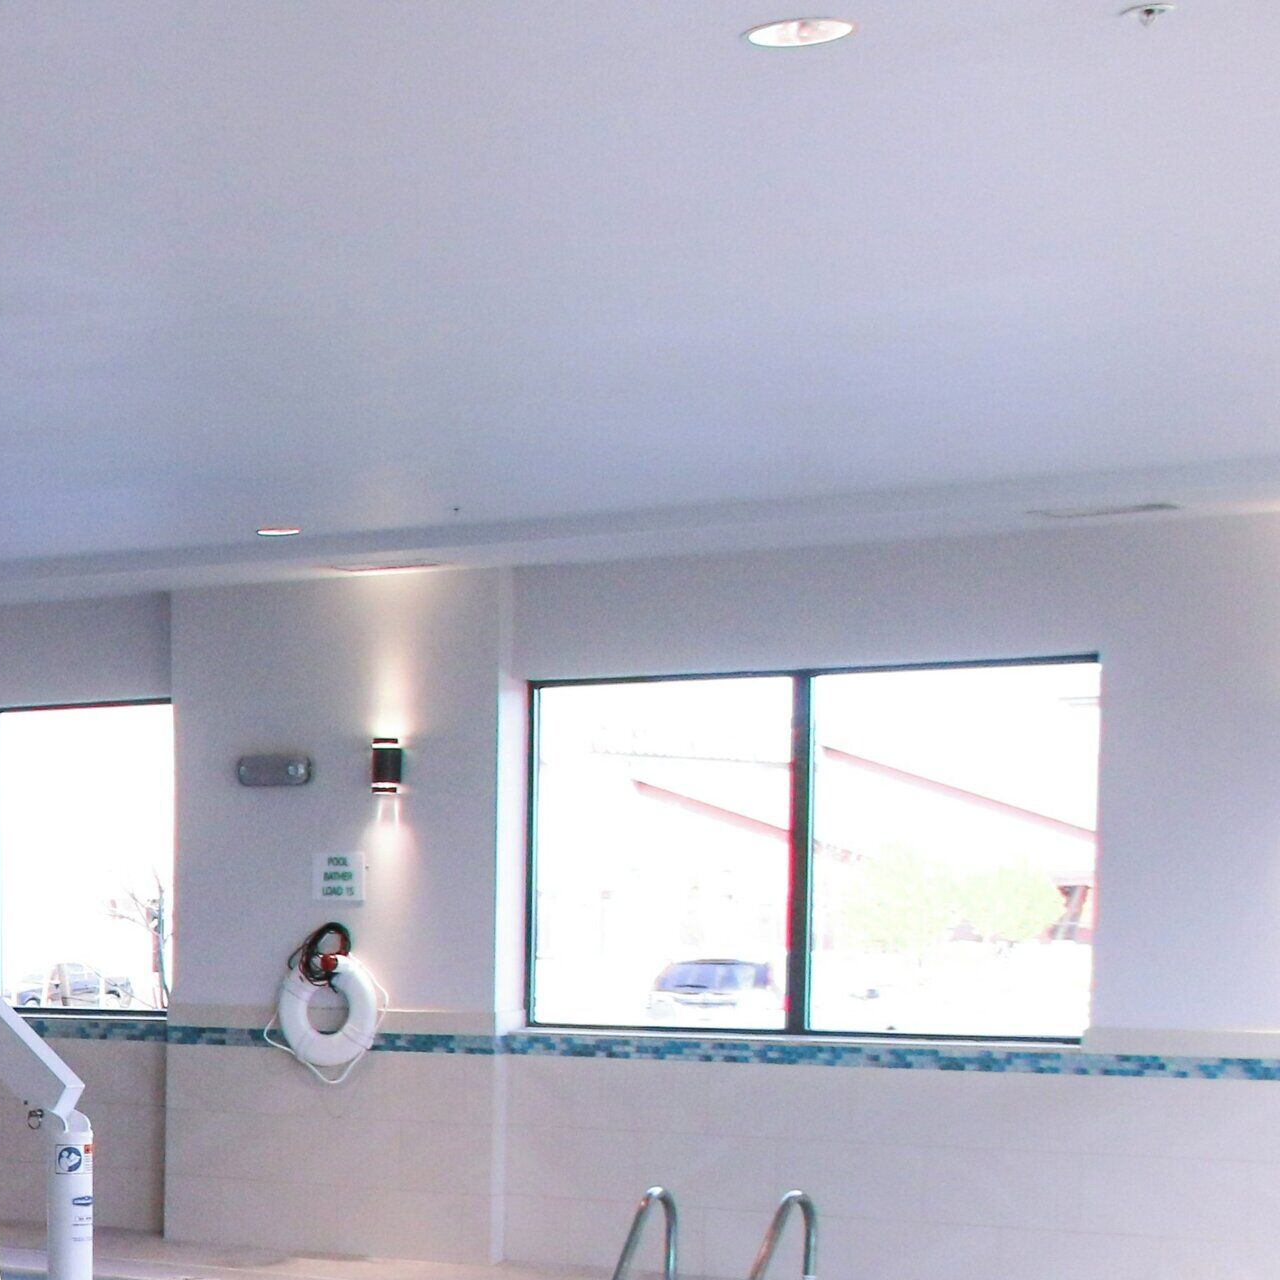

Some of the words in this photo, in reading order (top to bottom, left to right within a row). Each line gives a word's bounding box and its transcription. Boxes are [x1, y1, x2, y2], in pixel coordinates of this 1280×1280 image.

[327, 856, 348, 866] POOL
[323, 871, 352, 881] BATHER
[322, 886, 344, 896] LOAD
